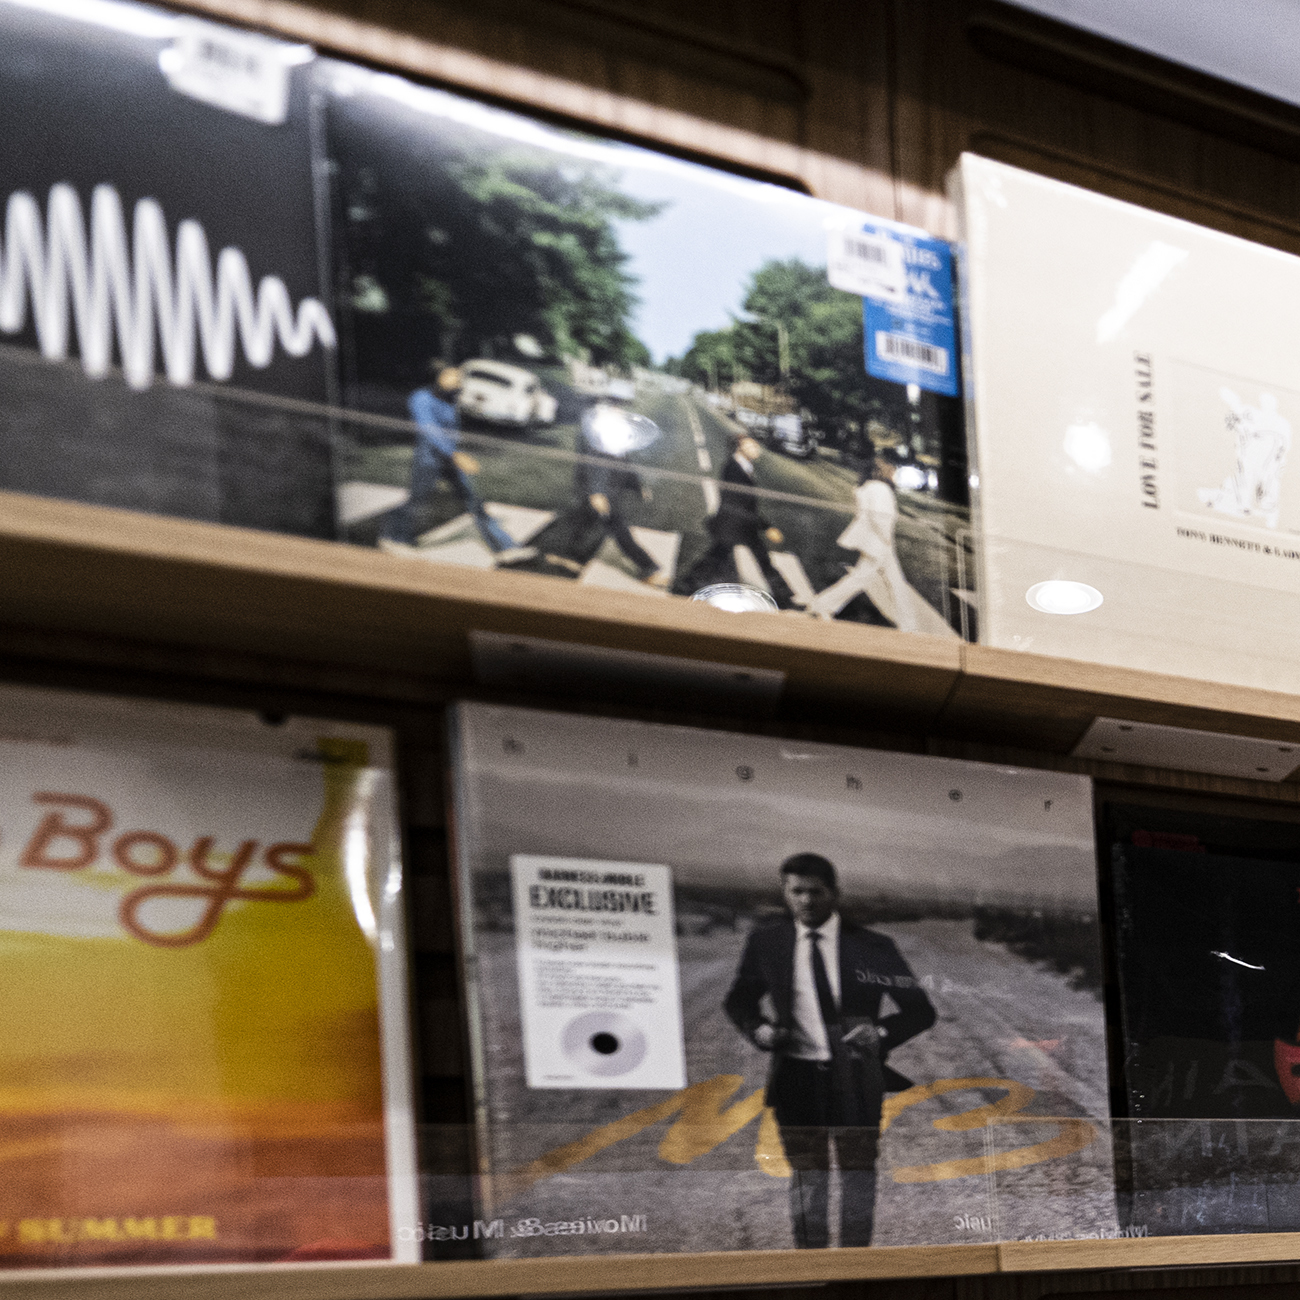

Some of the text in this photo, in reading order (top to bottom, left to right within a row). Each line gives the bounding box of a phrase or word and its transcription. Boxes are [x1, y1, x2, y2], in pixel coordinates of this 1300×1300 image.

[1134, 350, 1160, 510] LOVE FOR SALE
[18, 790, 317, 948] Boys
[18, 1215, 218, 1244] SUMMER
